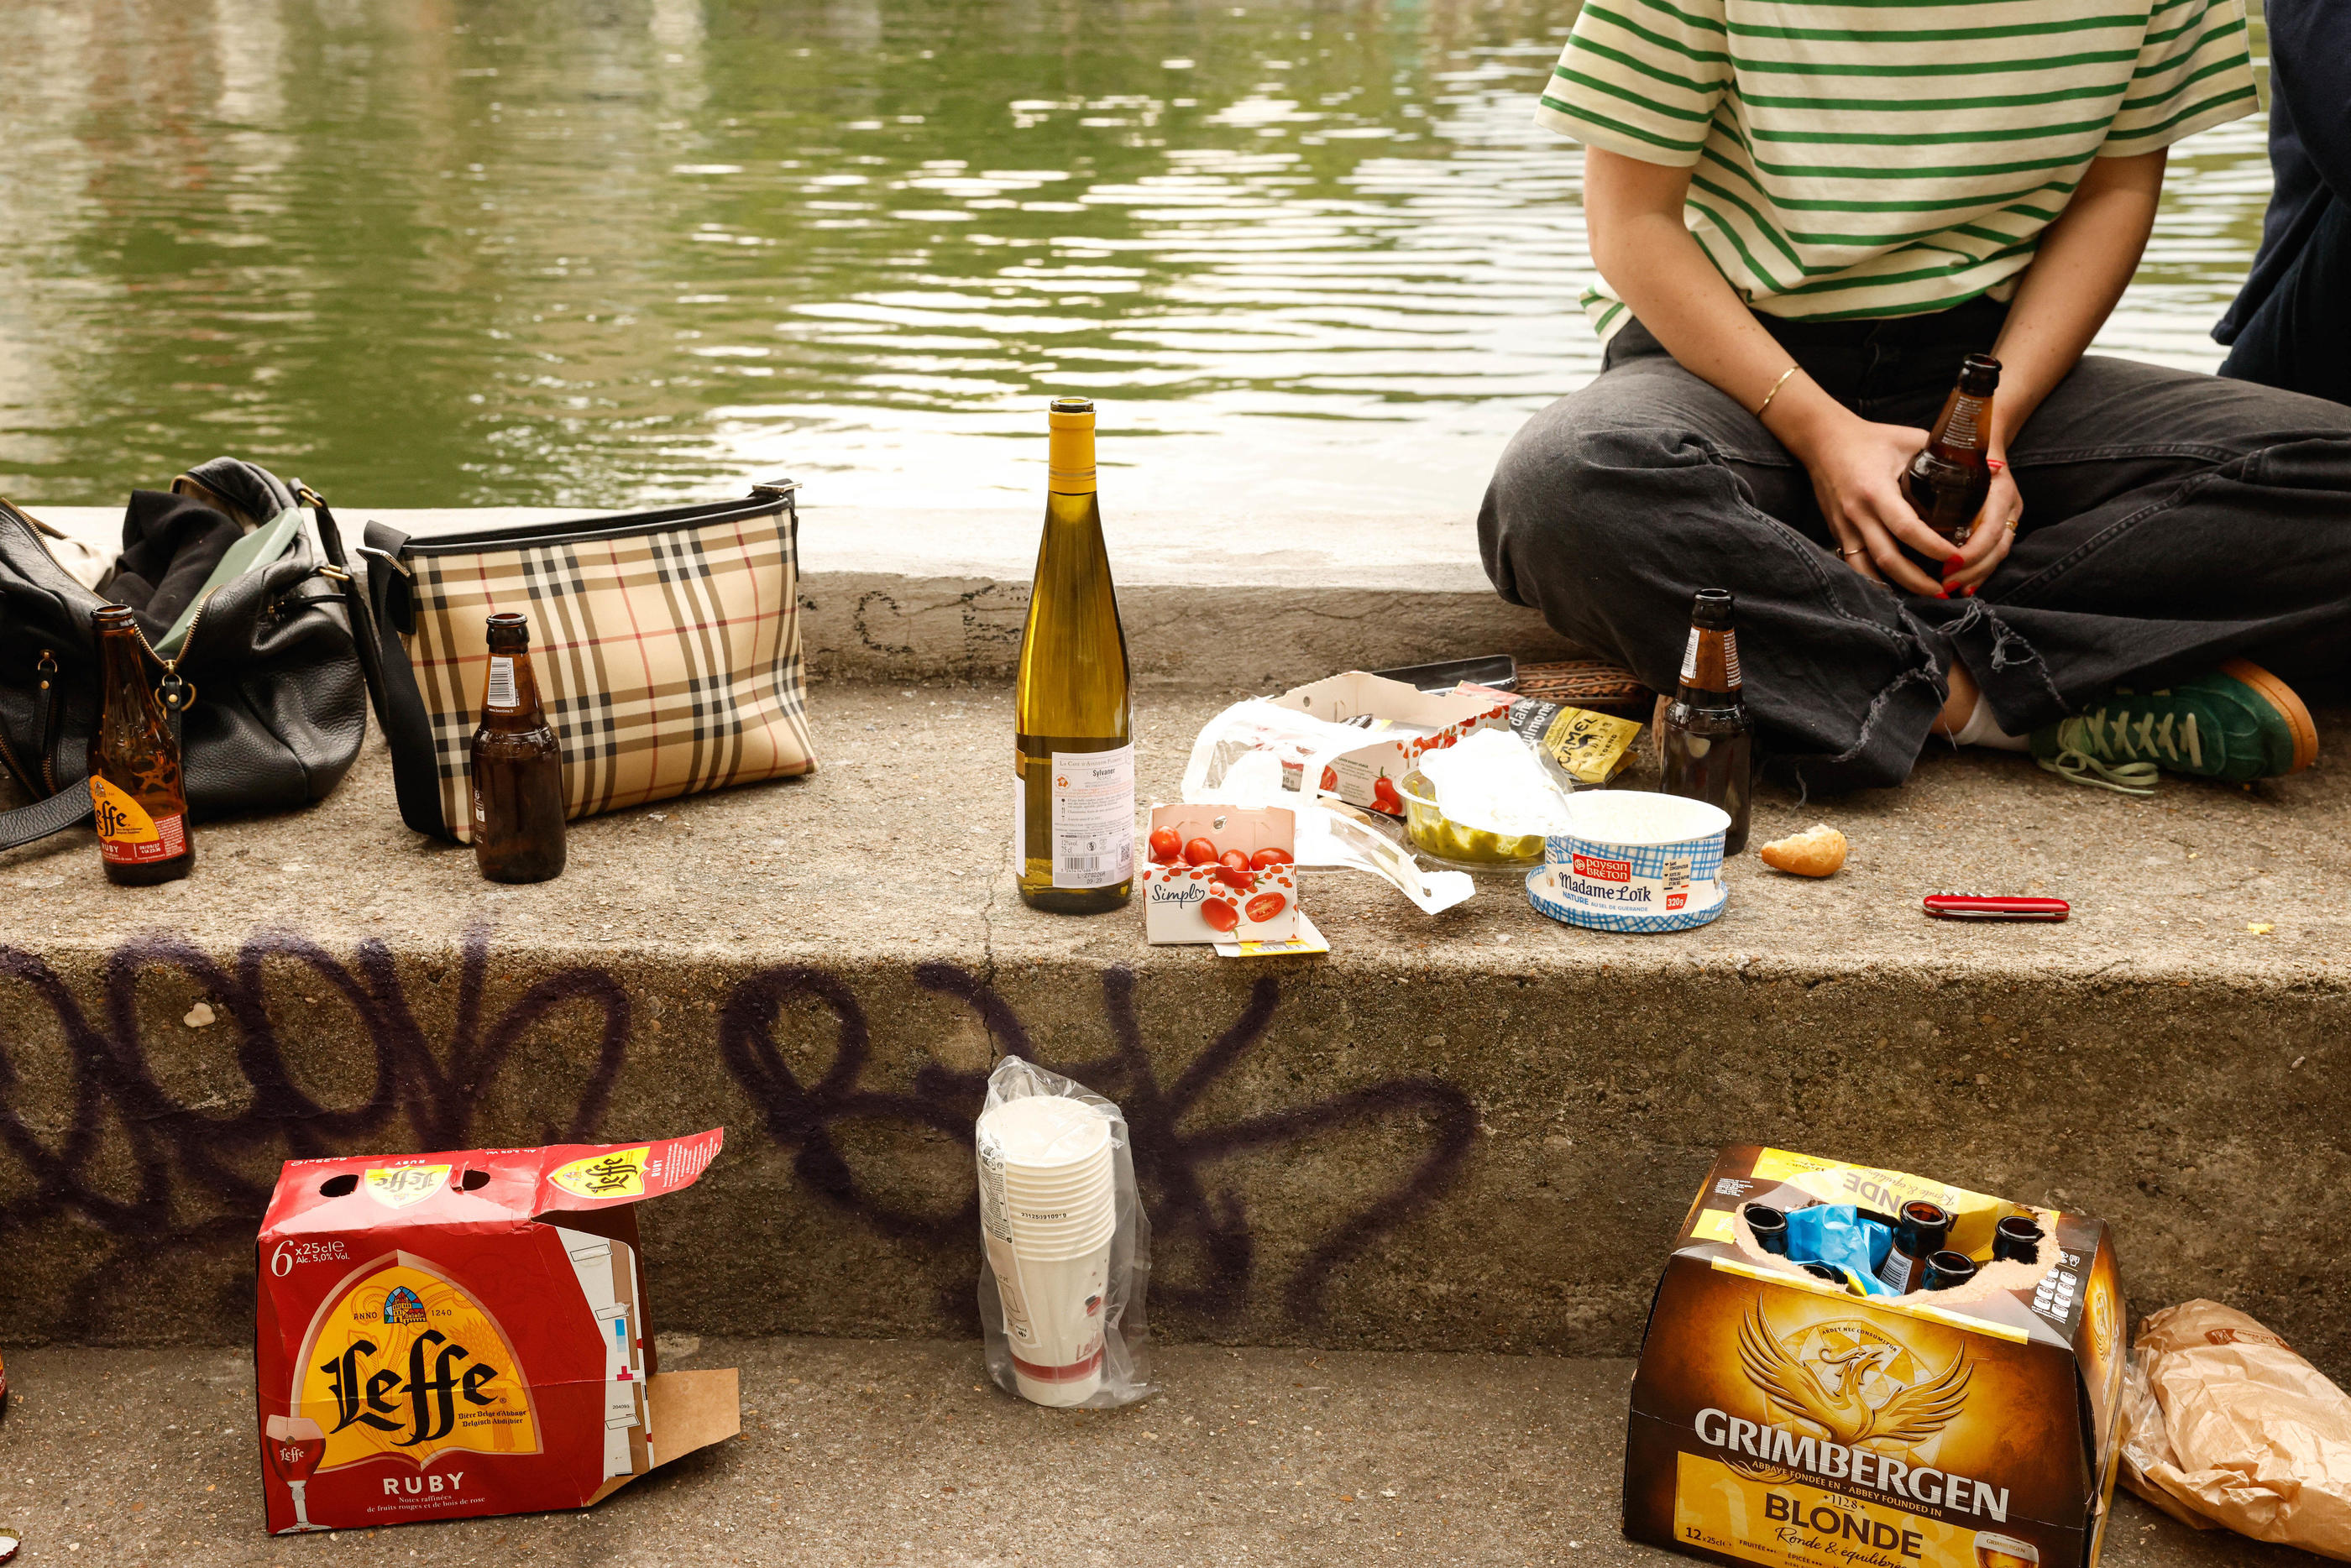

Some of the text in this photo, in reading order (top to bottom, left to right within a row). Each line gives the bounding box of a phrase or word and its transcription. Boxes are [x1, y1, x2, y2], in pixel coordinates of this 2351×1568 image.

[1557, 718, 1598, 765] CAMEL
[1092, 768, 1116, 778] Sylvaner
[92, 799, 128, 837] effe
[1559, 871, 1652, 902] Madame Loïk
[1562, 891, 1589, 906] NATURE
[584, 1157, 638, 1194] Leffe
[651, 1158, 663, 1178] RUBY
[374, 1168, 437, 1193] Leffe
[296, 1252, 350, 1264] Alc. 5,0% Vol.
[353, 1309, 453, 1320] ANNO 1240
[1856, 1329, 1898, 1353] CONSUMITUR
[320, 1329, 499, 1447] Leffe
[458, 1412, 476, 1420] Bière
[462, 1417, 524, 1427] Belgisch Abdijbier
[280, 1446, 305, 1464] Leffe
[1694, 1408, 2009, 1524] GRIMBERGEN
[383, 1471, 464, 1495] RUBY
[1751, 1460, 1788, 1477] ABBAYE
[1789, 1470, 1826, 1487] FONDÉE
[1828, 1480, 1841, 1491] EN
[1848, 1485, 1880, 1501] ABBEY
[1882, 1494, 1929, 1514] FOUNDED
[1930, 1508, 1943, 1518] IN
[398, 1493, 453, 1504] Notes raffinées
[1764, 1492, 1924, 1560] BLONDE
[1739, 1539, 1767, 1552] FRUITÉE
[1774, 1526, 1822, 1550] Ronde
[1825, 1541, 1839, 1556] &
[1788, 1552, 1810, 1564] ÉPICÉE
